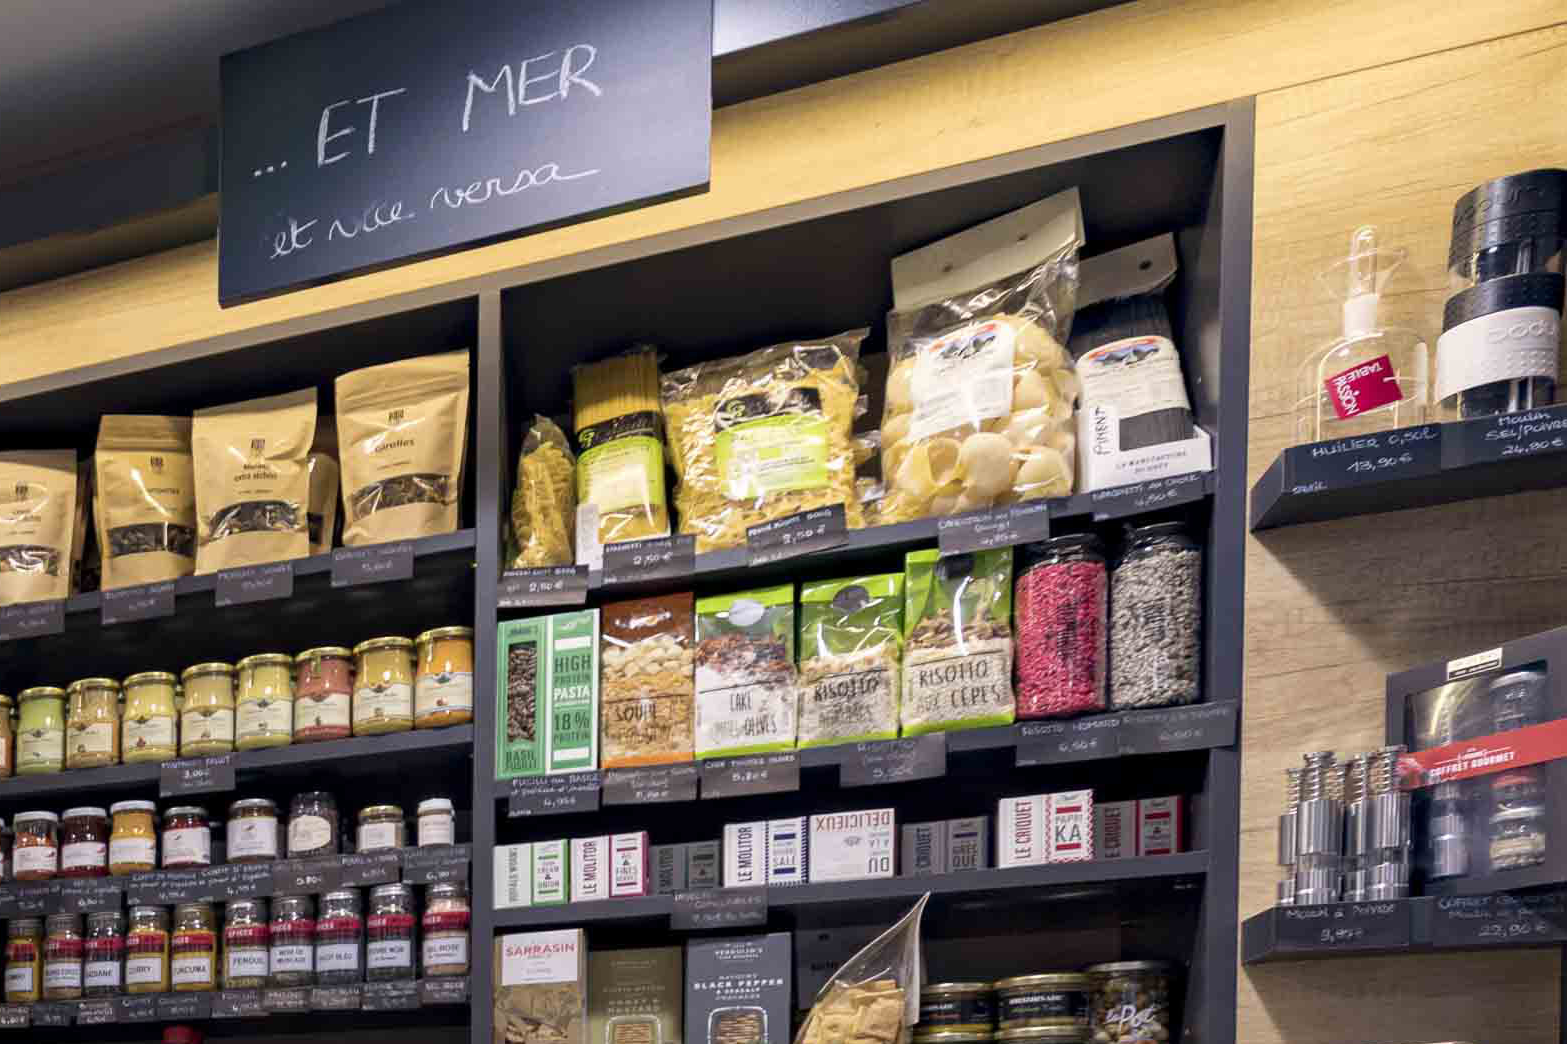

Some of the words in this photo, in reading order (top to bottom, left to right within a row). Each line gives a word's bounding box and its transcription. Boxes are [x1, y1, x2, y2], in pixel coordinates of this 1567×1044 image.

[317, 87, 407, 168] ET
[462, 43, 603, 133] MER
[270, 219, 319, 260] et
[430, 160, 601, 210] versa
[1312, 438, 1381, 457] HUILIER
[554, 654, 592, 672] HIGH
[919, 660, 989, 688] RISOTTO
[553, 685, 592, 701] PASTA
[553, 713, 572, 731] 18
[574, 711, 590, 729] %
[1015, 800, 1033, 845] CRIQUET
[1055, 824, 1082, 842] KA
[737, 826, 754, 869] MOLITOR
[1015, 846, 1033, 860] LE
[584, 840, 598, 881] MOLITOR
[868, 856, 891, 874] DU
[737, 871, 754, 883] LE
[584, 882, 598, 895] LE
[505, 943, 577, 958] SARRASIN
